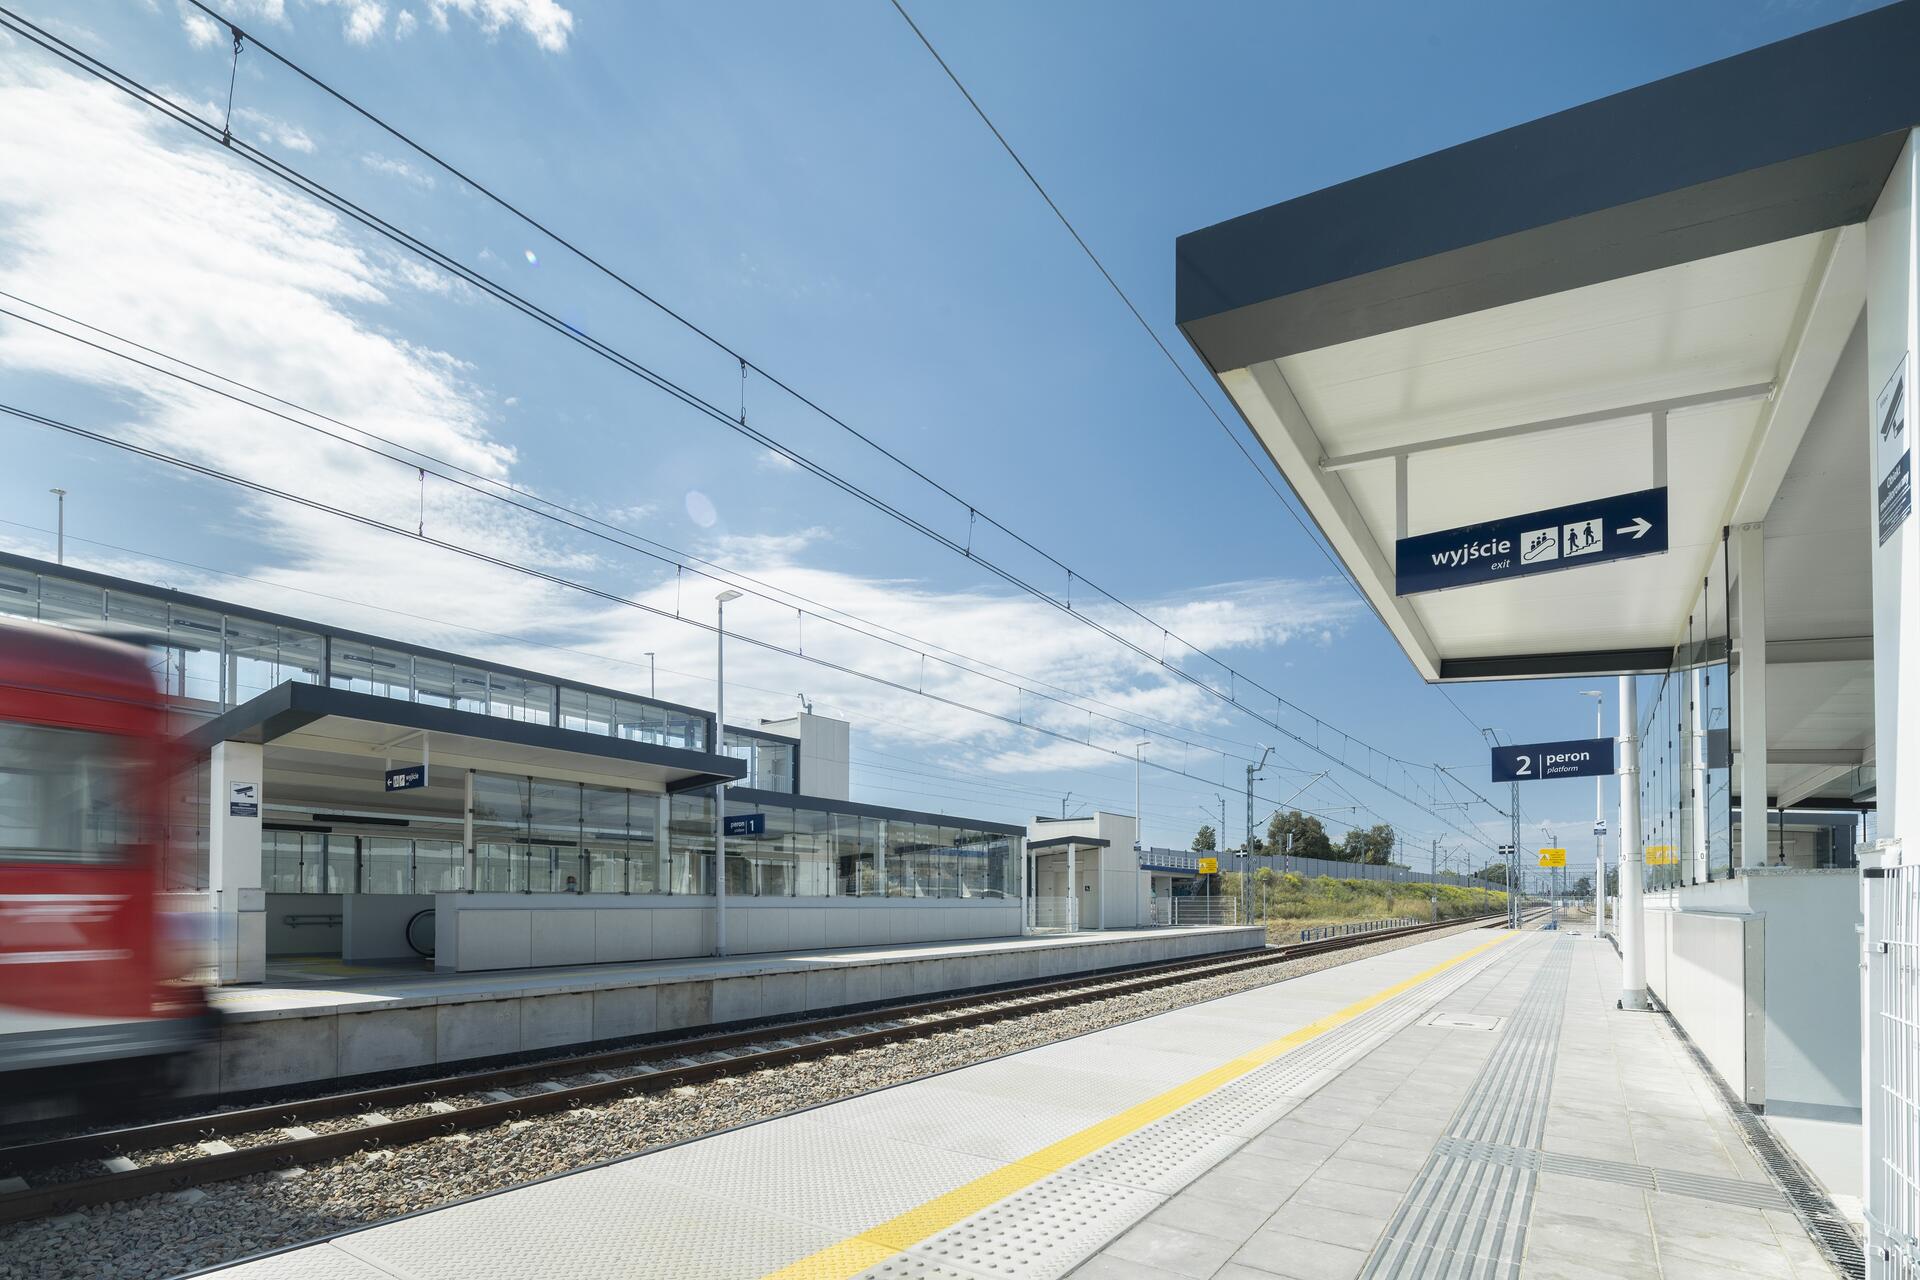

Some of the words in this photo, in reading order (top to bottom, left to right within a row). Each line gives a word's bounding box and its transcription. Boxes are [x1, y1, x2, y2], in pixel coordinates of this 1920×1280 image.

[1431, 538, 1511, 567] wyjście
[1490, 559, 1511, 571] exit
[1515, 755, 1532, 776] 2
[1546, 751, 1590, 767] peron
[1546, 766, 1579, 775] platform
[750, 819, 754, 831] 1
